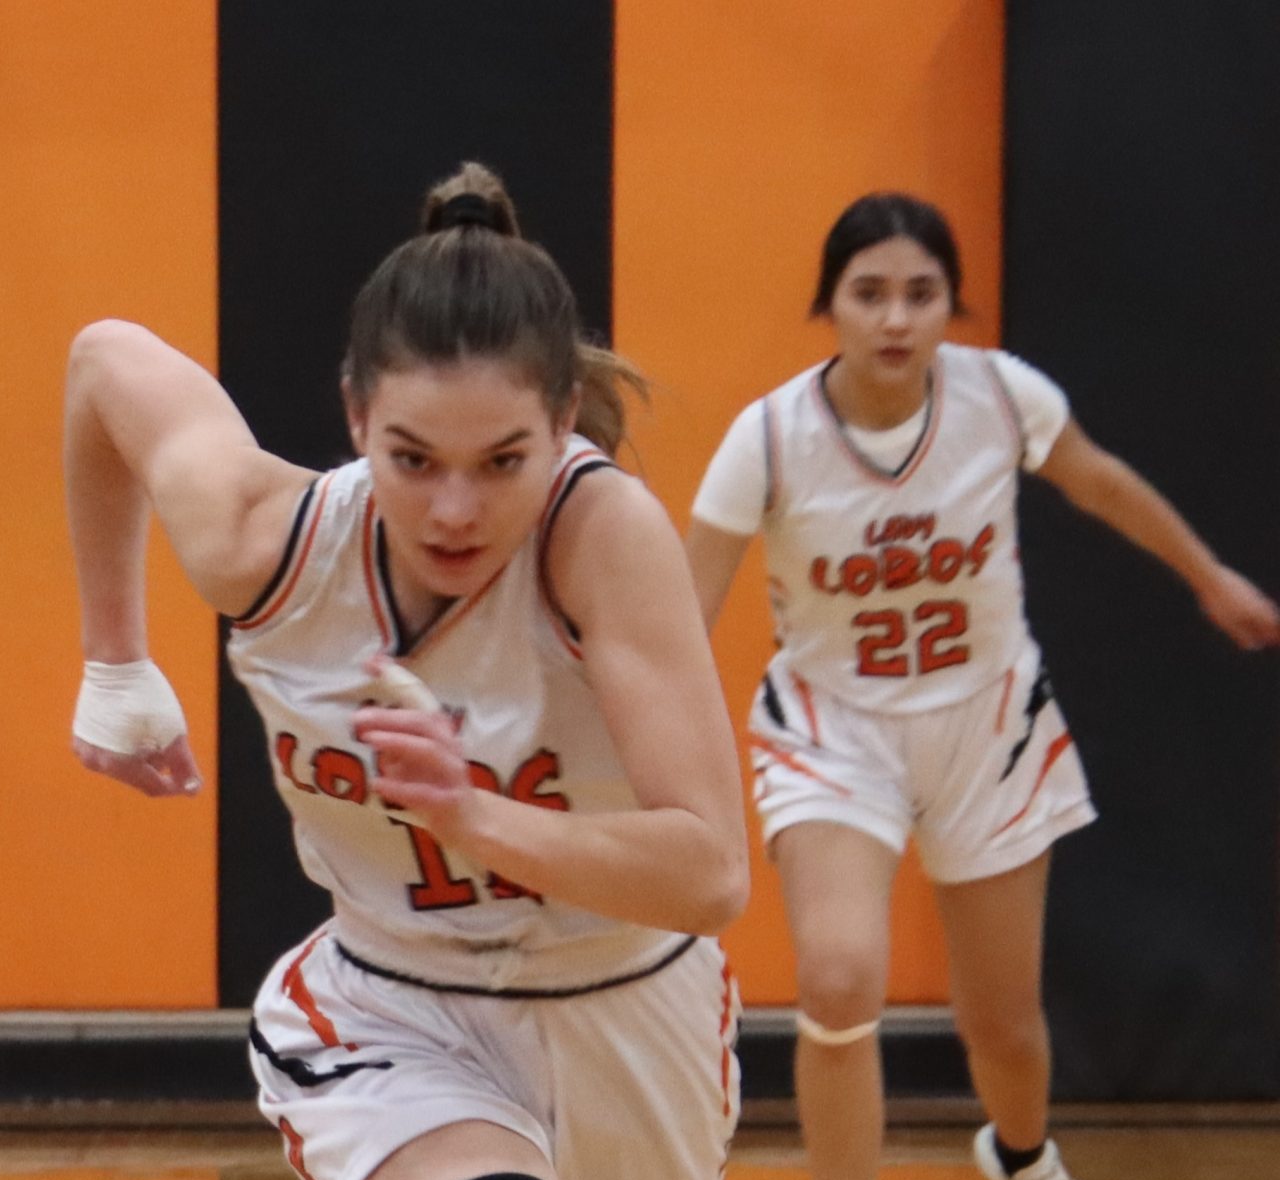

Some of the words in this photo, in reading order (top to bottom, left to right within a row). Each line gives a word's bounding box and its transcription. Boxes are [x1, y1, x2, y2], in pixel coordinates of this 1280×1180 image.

[809, 521, 996, 597] LOBOS
[851, 600, 972, 677] 22
[275, 731, 571, 813] LOS
[387, 815, 547, 912] 1
